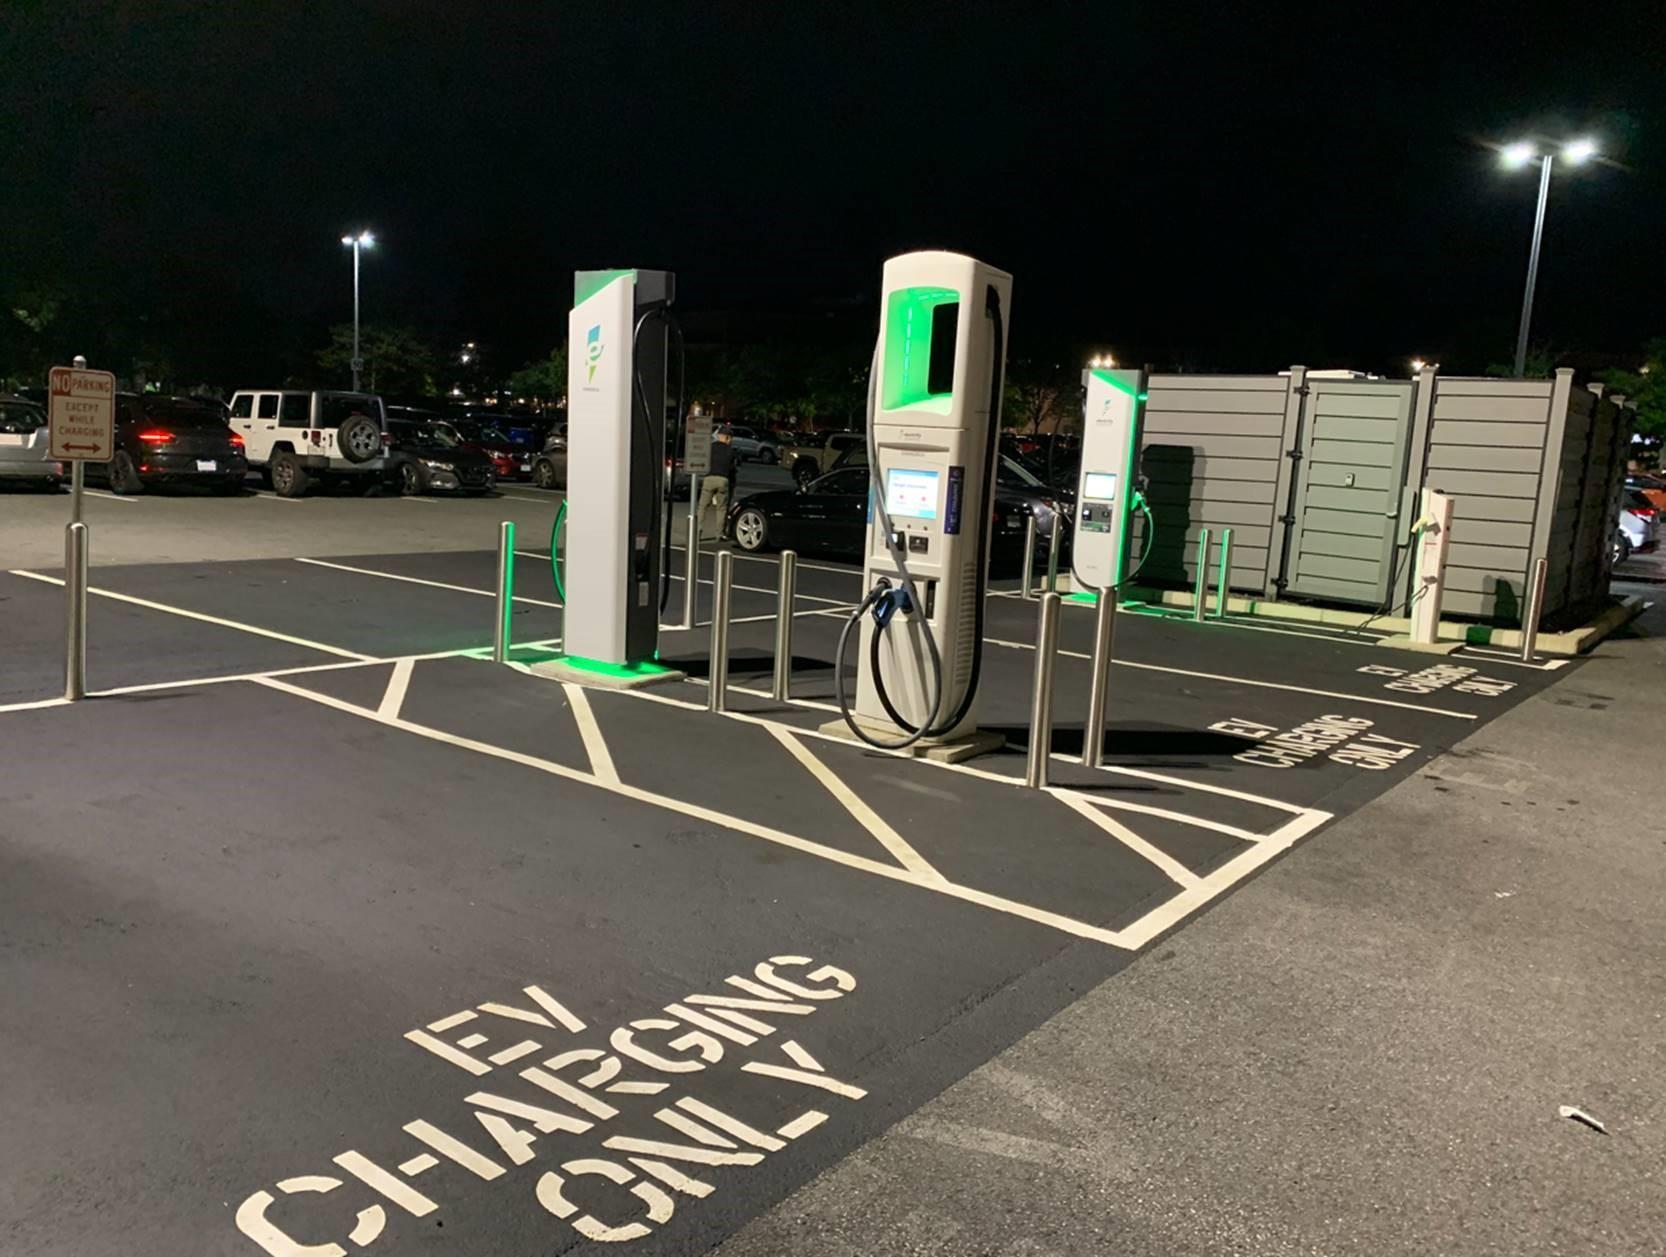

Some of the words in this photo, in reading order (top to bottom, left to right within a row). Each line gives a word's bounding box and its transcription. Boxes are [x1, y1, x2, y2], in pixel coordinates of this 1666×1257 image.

[52, 374, 70, 392] NO
[72, 378, 110, 393] PARKING
[65, 401, 99, 413] EXCEPT
[69, 415, 95, 425] WHILE
[59, 425, 104, 437] CHARGING
[1207, 717, 1279, 739] EV
[1232, 714, 1374, 768] CHARGING
[1328, 733, 1421, 770] ONLY
[403, 984, 588, 1076] EV
[235, 955, 857, 1257] CHARGING
[535, 1040, 869, 1243] ONLY
